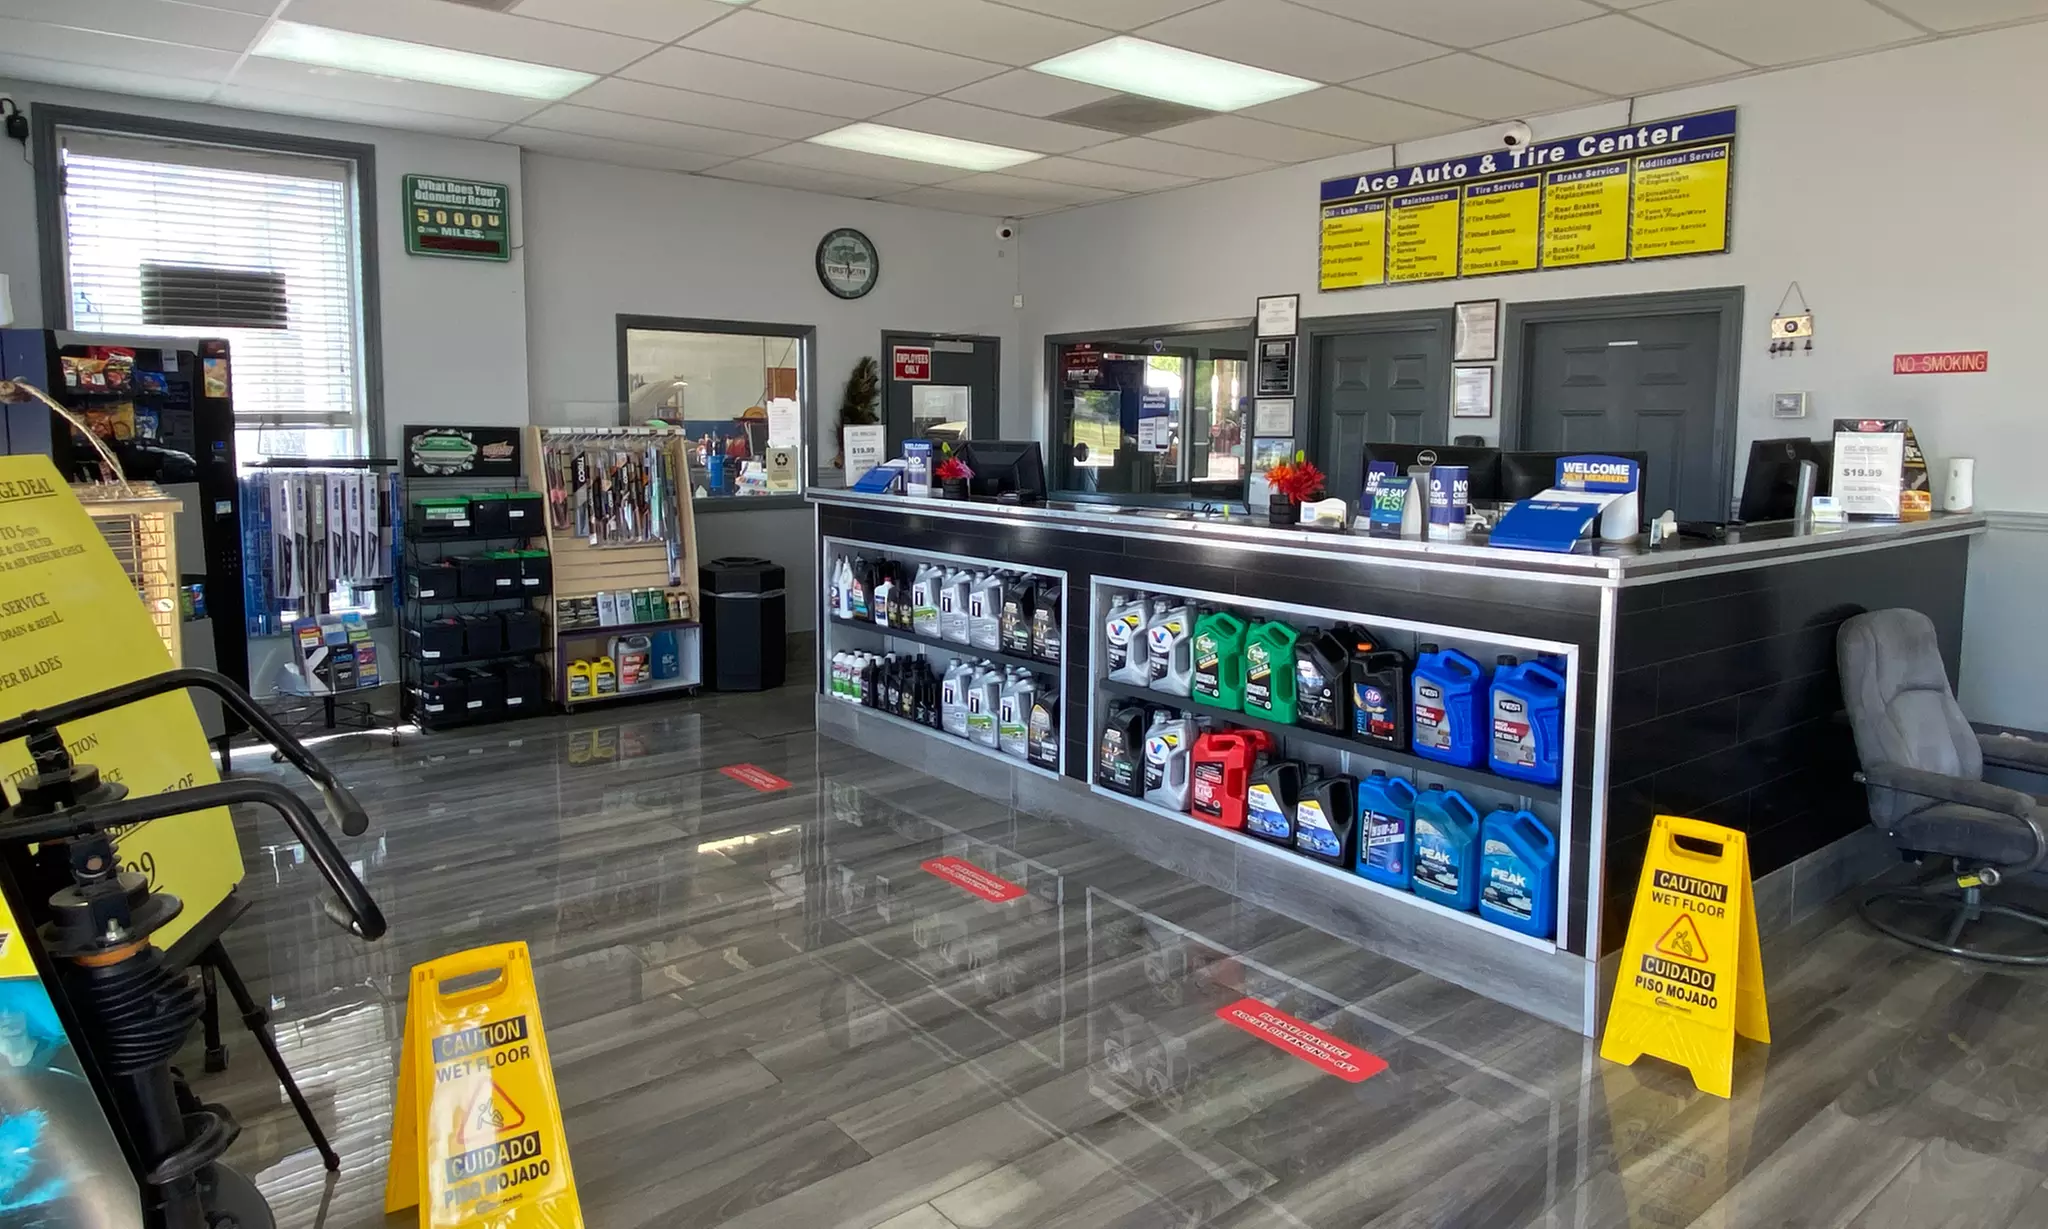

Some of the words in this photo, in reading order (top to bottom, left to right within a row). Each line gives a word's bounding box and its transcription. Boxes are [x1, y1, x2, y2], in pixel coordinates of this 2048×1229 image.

[1354, 176, 1399, 195] Ace
[1408, 163, 1467, 186] Auto
[1479, 154, 1497, 174] &
[1509, 146, 1565, 169] Tire
[1578, 124, 1684, 157] Center
[1639, 154, 1687, 169] Additional
[1689, 149, 1725, 162] Service
[1557, 172, 1583, 182] Brake
[1586, 165, 1620, 179] Service
[417, 179, 446, 191] What
[447, 182, 474, 195] Does
[474, 185, 497, 197] Your
[1475, 186, 1491, 195] Tire
[1493, 181, 1525, 193] Service
[1555, 184, 1575, 193] Front
[1577, 181, 1603, 190] Brakes
[1555, 189, 1603, 200] Replacement
[415, 189, 467, 204] Odometer
[468, 195, 501, 208] Read?
[1364, 203, 1384, 212] Filter
[1401, 193, 1449, 206] Maintenance
[1573, 203, 1600, 211] Brakes
[1554, 210, 1602, 221] Replacement
[441, 227, 485, 239] MILES
[1553, 224, 1591, 233] Machining
[1553, 246, 1575, 254] Brake
[1576, 243, 1595, 251] Fluid
[896, 353, 929, 364] EMPLOYEES
[1896, 356, 1915, 373] NO
[1922, 354, 1985, 372] SMOKING
[904, 364, 920, 375] ONLY
[577, 456, 585, 482] TRICO
[908, 456, 921, 465] NO
[1563, 462, 1630, 475] WELCOME
[1843, 468, 1882, 477] $19.99
[16, 478, 55, 496] DEAL
[1376, 487, 1390, 497] WE
[1389, 488, 1407, 498] SAY
[1373, 495, 1404, 512] YES!
[1, 592, 50, 616] SERVICE
[0, 624, 28, 641] DRAIN
[28, 623, 36, 632] &
[34, 610, 64, 630] REFILL
[18, 655, 63, 682] BLADES
[1494, 724, 1518, 733] MILEAGE
[68, 733, 99, 757] TION
[1419, 846, 1450, 865] PEAK
[1491, 868, 1526, 887] PEAK
[1660, 872, 1722, 900] CAUTION
[1490, 881, 1513, 893] MOTOR
[1652, 890, 1680, 907] WET
[1682, 898, 1725, 919] FLOOR
[1645, 957, 1712, 988] CUIDADO
[1635, 975, 1663, 993] PISO
[1666, 983, 1718, 1010] MOJADO
[442, 1019, 521, 1057] CAUTION
[1232, 1009, 1266, 1030] SOCIAL
[1267, 1027, 1329, 1060] DISTANCING
[1259, 1011, 1298, 1034] PLEASE
[1298, 1030, 1352, 1059] PRACTICE
[436, 1059, 472, 1083] WET
[475, 1045, 530, 1073] FLOOR
[452, 1135, 537, 1178] CUIDADO
